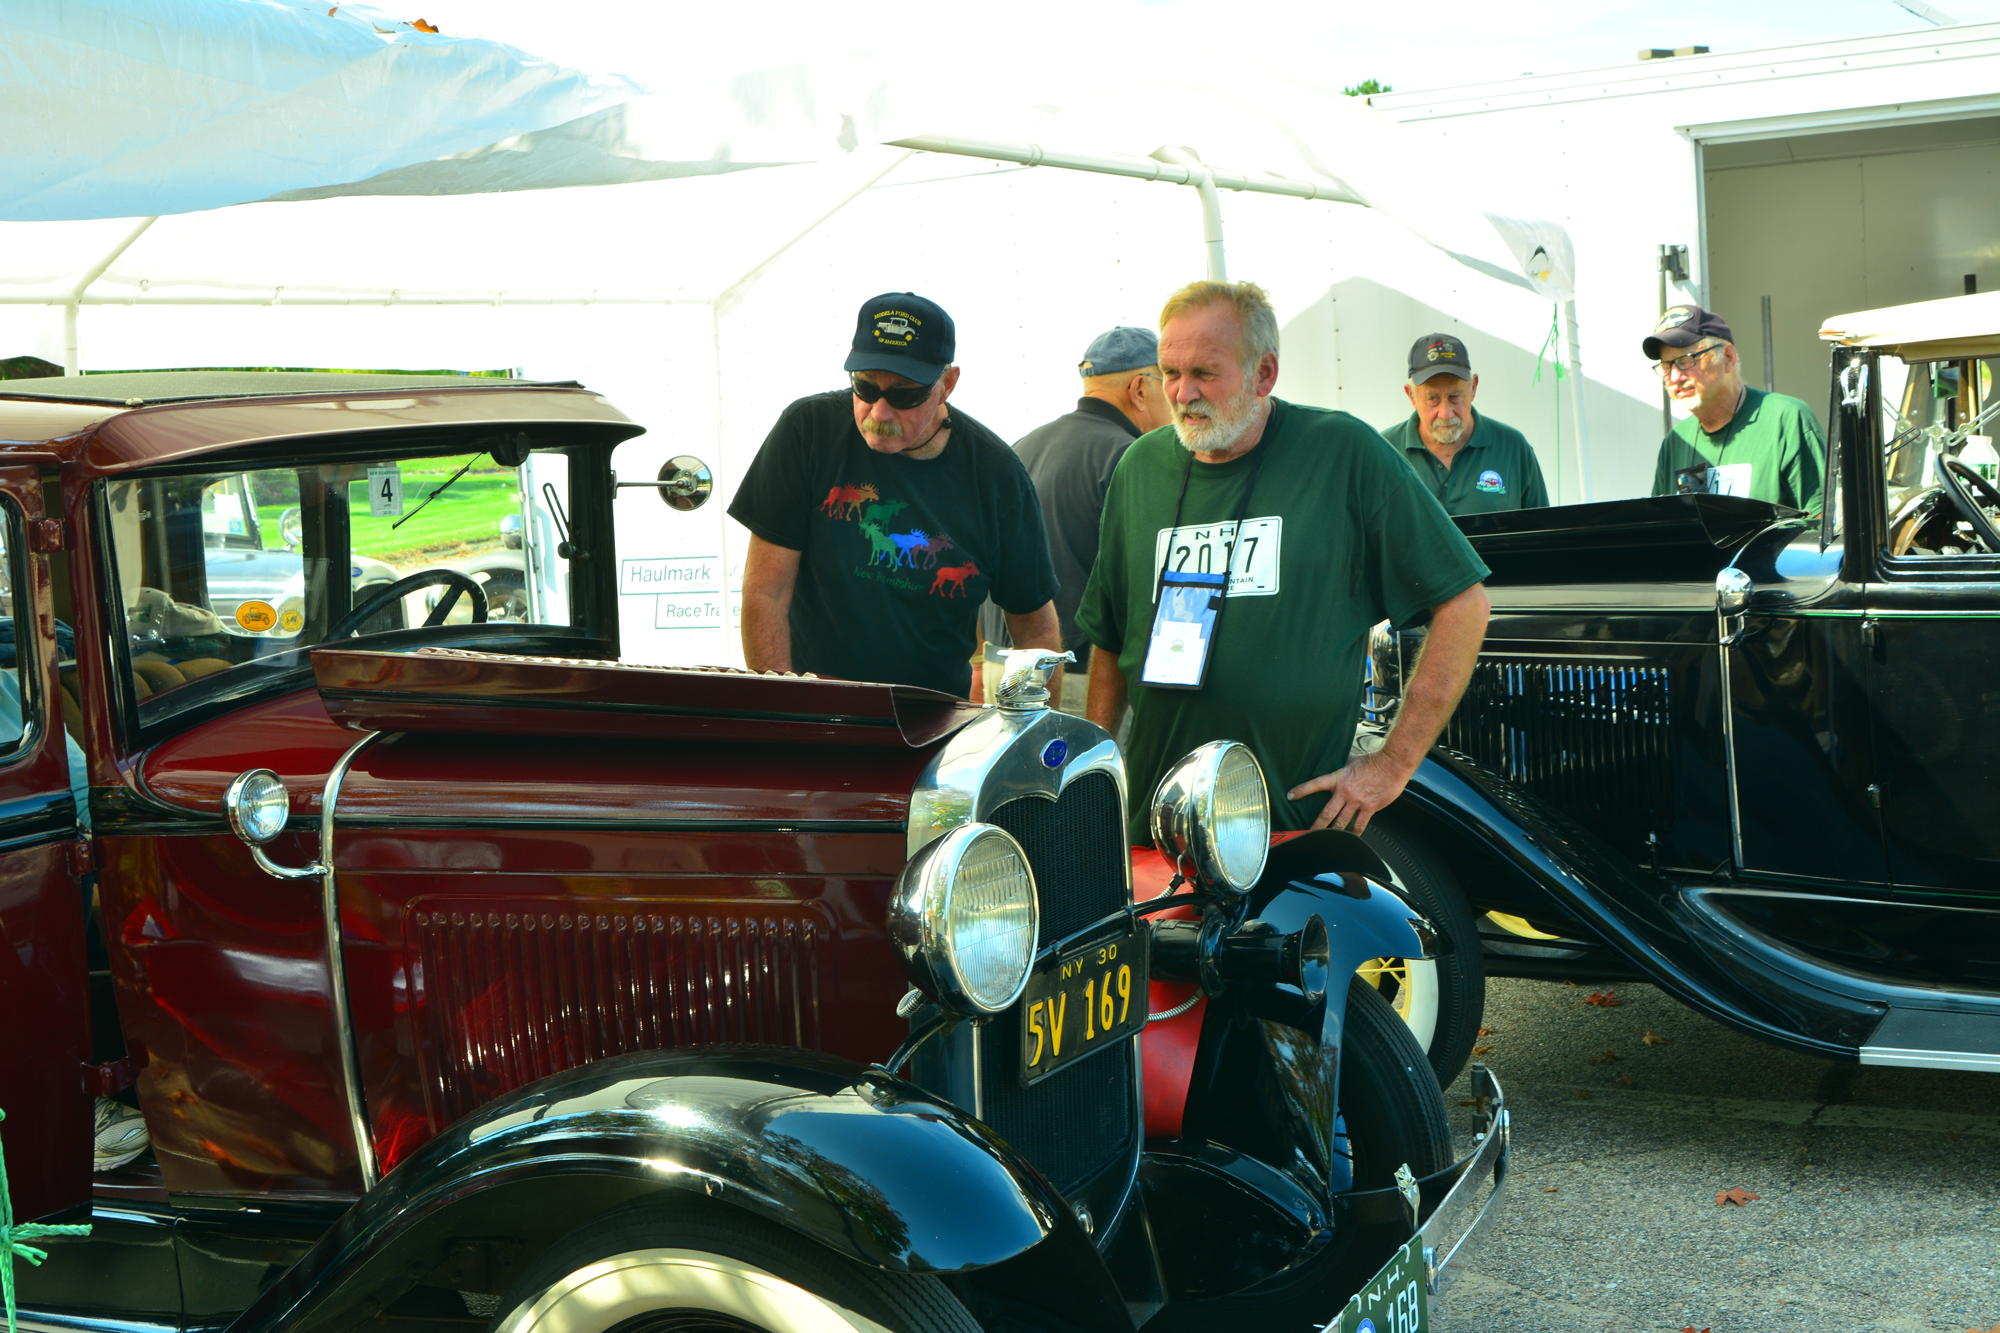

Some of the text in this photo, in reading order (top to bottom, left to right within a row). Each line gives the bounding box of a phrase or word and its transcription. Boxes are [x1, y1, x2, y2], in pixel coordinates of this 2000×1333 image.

[873, 310, 890, 319] MODEL
[895, 310, 909, 319] FORD
[909, 315, 922, 326] CLUB
[381, 478, 393, 502] 4
[631, 563, 711, 583] Haulmark
[1176, 537, 1259, 574] 2017
[1061, 944, 1118, 981] NY 30
[1028, 963, 1131, 1067] 5V 169
[1367, 1264, 1405, 1310] N.H.
[1387, 1280, 1419, 1333] 168
